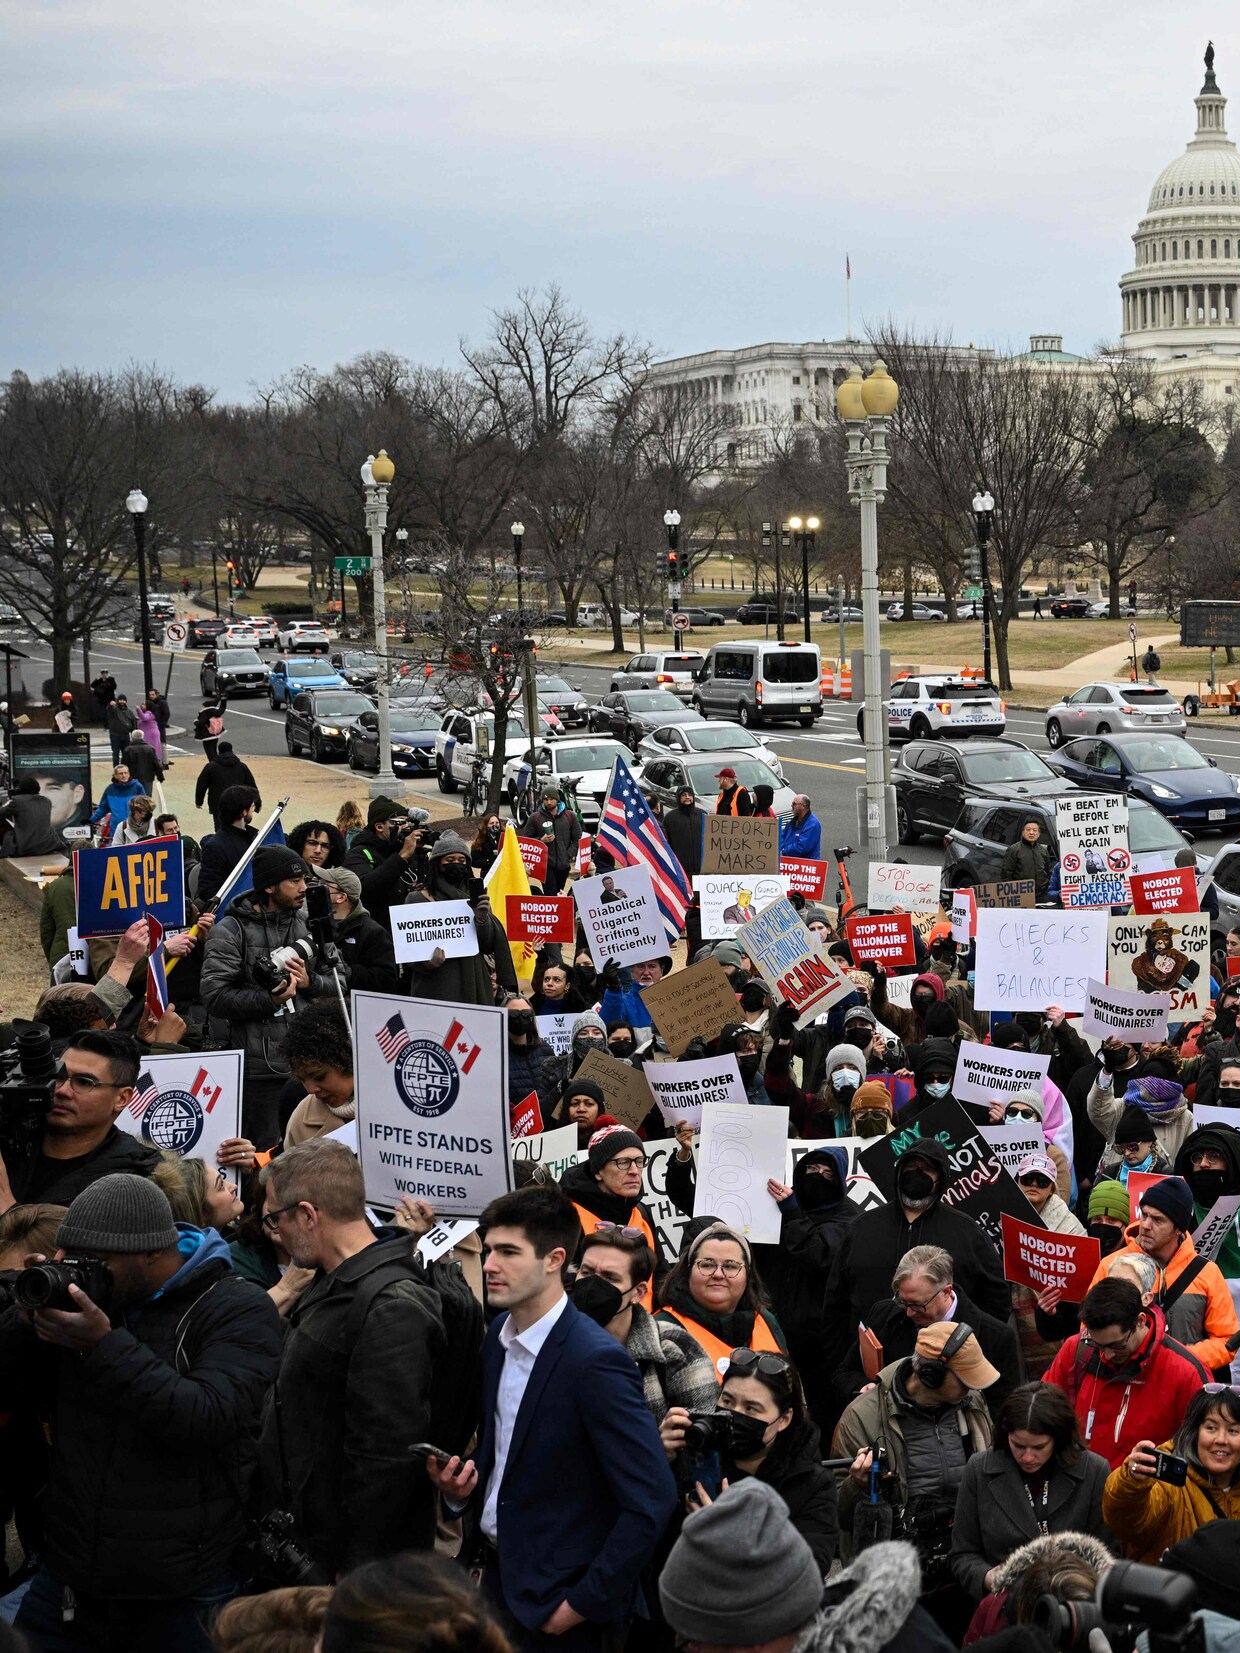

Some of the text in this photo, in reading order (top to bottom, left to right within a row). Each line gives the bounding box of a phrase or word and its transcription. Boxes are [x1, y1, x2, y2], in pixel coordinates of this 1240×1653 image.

[346, 559, 353, 569] 2
[888, 708, 912, 718] POLICE
[456, 754, 469, 765] POLICE
[1058, 803, 1071, 811] WE
[1076, 800, 1099, 810] BEAT
[1073, 811, 1109, 822] BEFORE
[711, 820, 776, 837] DEPORT
[1058, 828, 1081, 838] WE'LL
[1085, 826, 1109, 836] BEAT
[710, 837, 772, 850] MUSK TO
[1078, 837, 1110, 848] AGAIN
[717, 853, 767, 871] MARS
[101, 850, 168, 910] AFGE
[877, 867, 910, 882] STOP
[1064, 873, 1125, 884] FIGHT FASCISM
[706, 881, 745, 894] QUACK
[894, 881, 934, 892] DOGE
[996, 881, 1034, 896] POWER
[1080, 882, 1122, 893] DEFEND
[1143, 876, 1182, 890] NOBODY
[1070, 891, 1127, 906] DEMOCRACY
[1144, 887, 1183, 900] ELECTED
[520, 903, 558, 913] NOBODY
[589, 896, 646, 919] Diabolical
[982, 899, 995, 908] TO
[1152, 898, 1179, 910] MUSK
[397, 916, 471, 930] WORKERS OVER
[521, 914, 559, 923] ELECTED
[592, 911, 641, 931] Oligarch
[527, 925, 552, 934] MUSK
[741, 898, 801, 956] IMPEACH
[856, 923, 898, 935] STOP THE
[1115, 924, 1208, 940] ONLY CAN
[406, 928, 465, 943] BILLIONAIRES!
[596, 926, 639, 944] Grifting
[852, 934, 907, 947] BILLIONAIRE
[999, 922, 1089, 950] CHECKS
[600, 935, 657, 956] Efficiently
[757, 927, 811, 978] TRUMP
[858, 947, 902, 959] TAKEOVER
[1111, 940, 1208, 955] YOU STOP
[1033, 947, 1044, 965] &
[672, 985, 690, 998] racist
[997, 974, 1088, 999] BALANCES
[680, 998, 693, 1008] not
[696, 989, 718, 1001] enough
[1090, 995, 1164, 1017] WORKERS OVER
[1094, 1009, 1155, 1028] BILLIONAIRES!
[663, 1023, 675, 1032] be
[670, 1029, 688, 1043] must
[691, 1024, 702, 1032] be
[401, 1041, 426, 1058] CENTURY
[435, 1043, 456, 1071] SERVICE
[963, 1059, 1041, 1080] WORKERS OVER
[404, 1071, 449, 1085] IFPTE
[652, 1074, 734, 1092] WORKERS OVER
[967, 1072, 1032, 1091] BILLIONAIRES!
[150, 1092, 173, 1112] CENTURY
[182, 1092, 200, 1112] SERVICE
[660, 1089, 729, 1108] BILLIONAIRES!
[413, 1105, 440, 1116] EST 1918
[151, 1118, 195, 1130] IFPTE
[369, 1122, 493, 1154] IFPTE STANDS
[1015, 1140, 1039, 1151] OVER
[379, 1151, 483, 1176] WITH FEDERAL
[394, 1178, 467, 1199] WORKERS
[1019, 1232, 1076, 1258] NOBODY
[1020, 1248, 1076, 1274] ELECTED
[1029, 1267, 1068, 1288] MUSK
